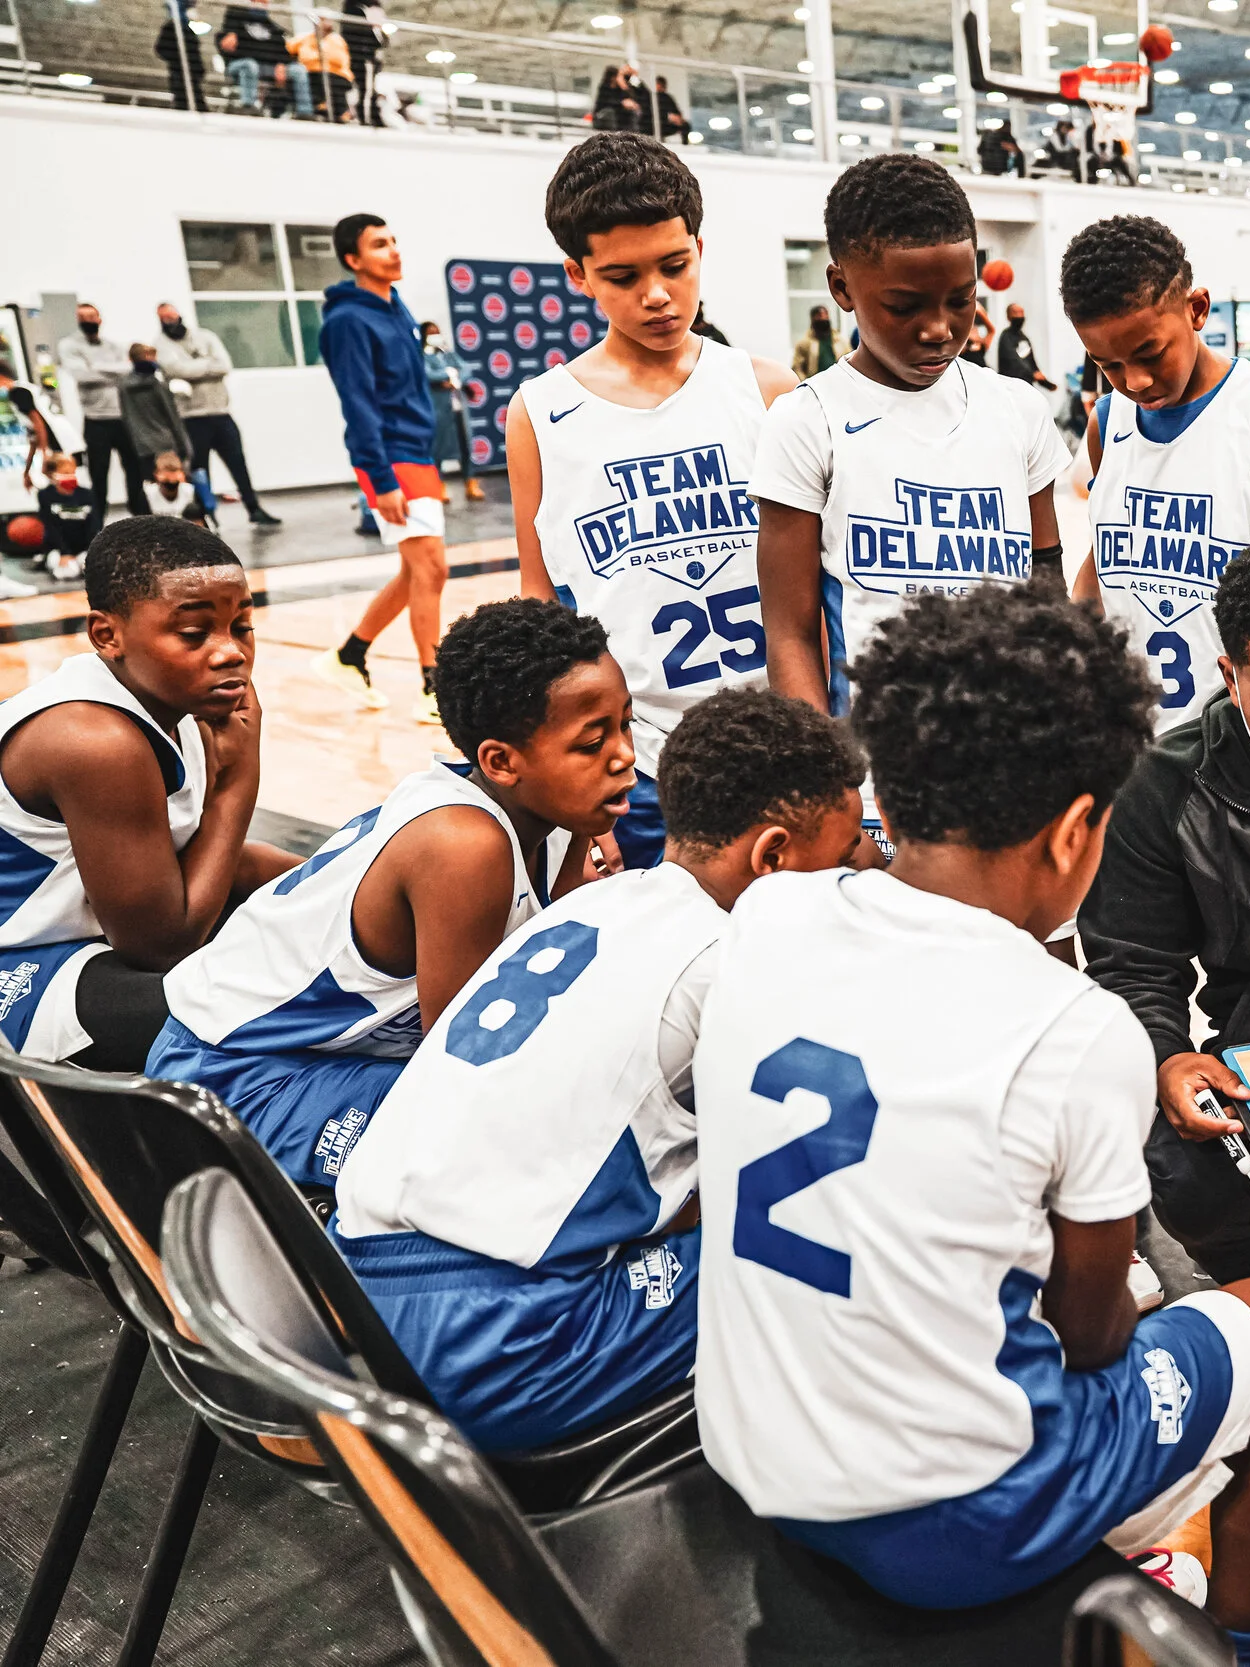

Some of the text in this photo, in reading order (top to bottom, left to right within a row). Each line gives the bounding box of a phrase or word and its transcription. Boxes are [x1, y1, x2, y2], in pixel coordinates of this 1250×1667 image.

[613, 449, 723, 500] TEAM
[581, 489, 759, 564] DELAWAR
[903, 485, 1001, 531] TEAM
[1128, 491, 1207, 535] TEAM
[630, 535, 752, 566] BASKETBALL
[1101, 530, 1246, 581] DELAWAR
[905, 583, 970, 598] BASKE
[1130, 580, 1217, 601] ASKETBALL
[651, 585, 767, 690] 25
[1146, 631, 1196, 709] 3
[445, 920, 600, 1067] 8
[316, 1120, 341, 1157] TEAM
[325, 1110, 365, 1176] DELAWARE
[1221, 1135, 1239, 1158] Spor
[733, 1036, 879, 1299] 2
